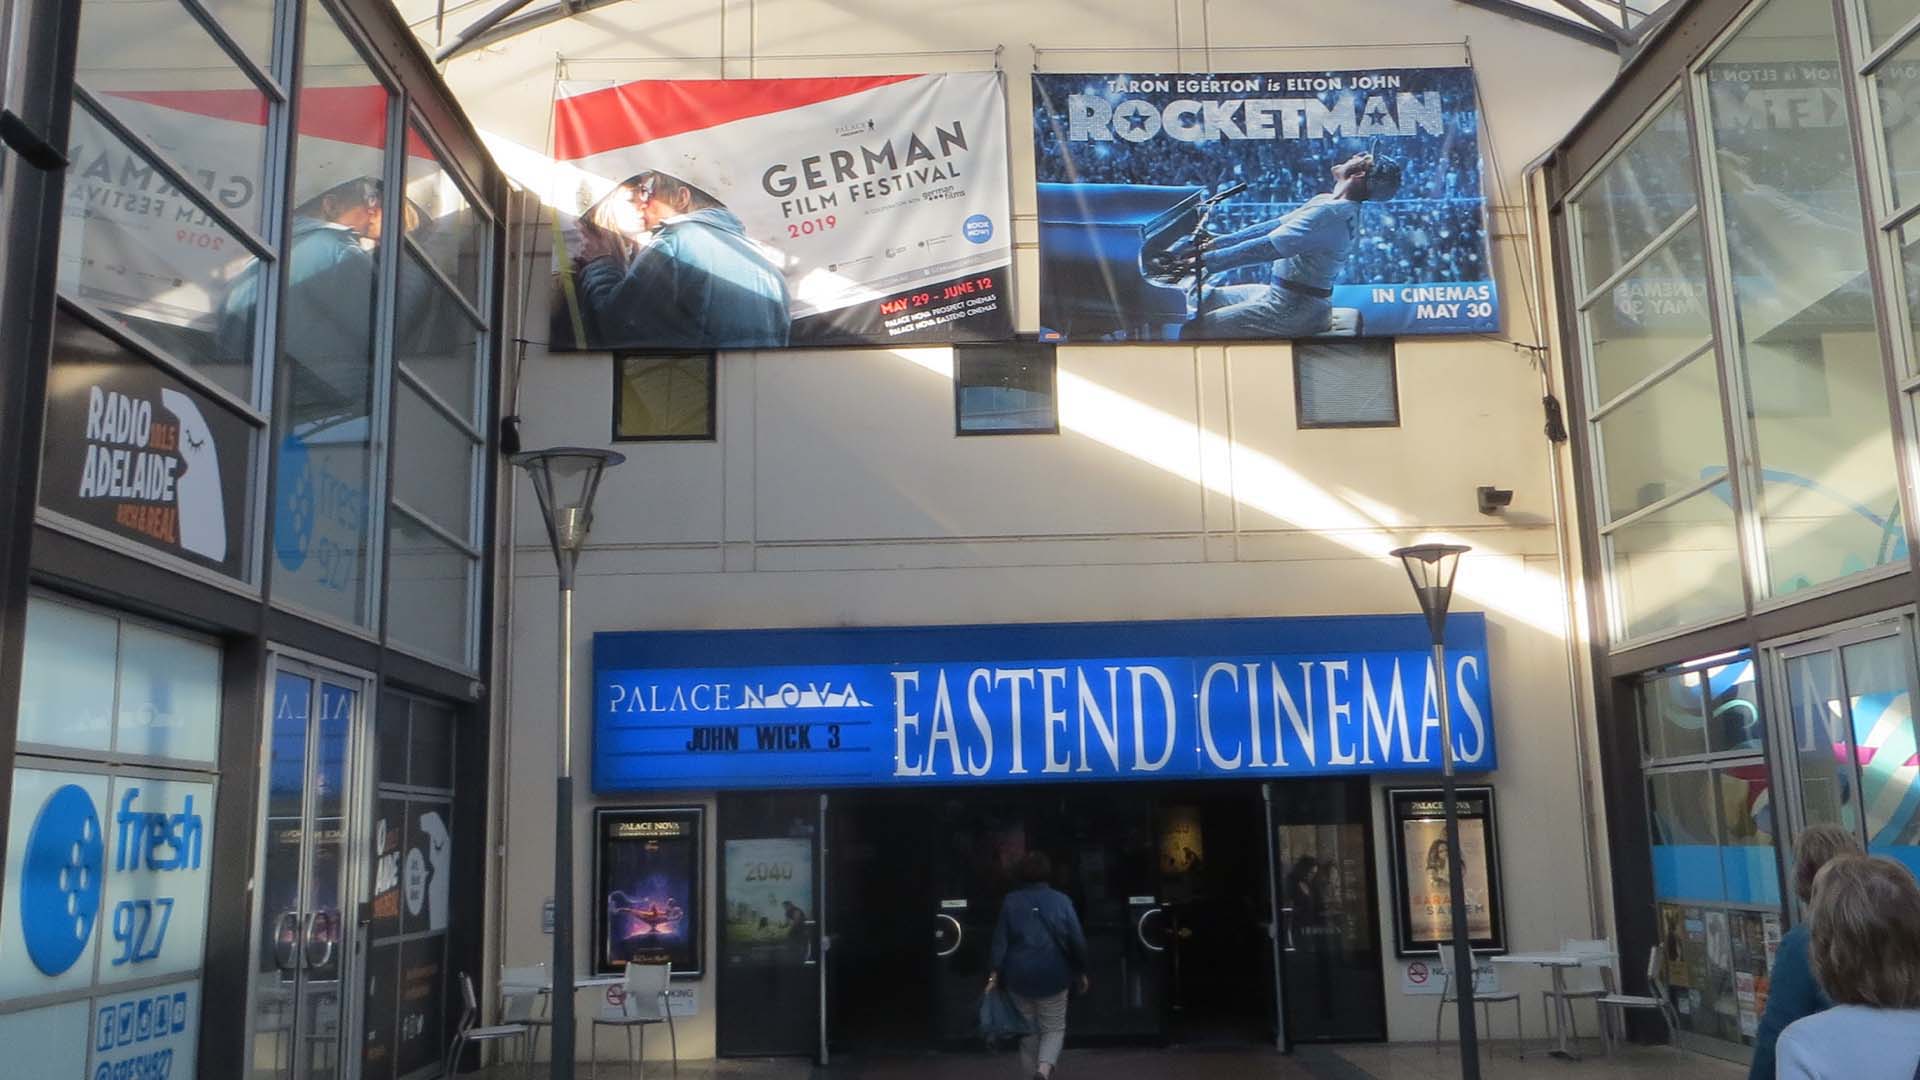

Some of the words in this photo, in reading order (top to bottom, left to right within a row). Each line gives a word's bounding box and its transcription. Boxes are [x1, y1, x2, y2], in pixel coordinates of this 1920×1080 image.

[1107, 79, 1169, 95] TARON
[1176, 78, 1260, 93] EGERTON
[1267, 78, 1281, 92] is
[1287, 77, 1342, 92] ELTON
[1350, 74, 1401, 90] JOHN
[1068, 90, 1445, 143] ROCKETMAN
[762, 121, 968, 197] GERMAN
[781, 192, 838, 218] FILM
[849, 162, 960, 202] FESTIVAL
[787, 215, 837, 238] 2019
[880, 298, 910, 315] MAY
[911, 293, 930, 307] 29
[943, 280, 975, 300] JUNE
[976, 277, 993, 292] 12
[885, 314, 911, 328] PALACE
[911, 311, 932, 323] NOVA
[932, 302, 966, 317] PROSPECT
[966, 294, 997, 306] CINEMAS
[1372, 288, 1395, 304] IN
[1401, 286, 1491, 303] CINEMAS
[1416, 304, 1461, 320] MAY
[1466, 302, 1492, 319] 30
[888, 324, 915, 336] PALACE
[916, 319, 937, 331] NOVA
[936, 311, 967, 326] EASTEND
[967, 303, 997, 316] CINEMAS
[86, 384, 152, 448] RADIO
[79, 444, 177, 501] ADELAIDE
[609, 683, 731, 713] PALACE
[734, 682, 874, 710] NOVA
[891, 665, 1177, 777] EASTEND
[1200, 655, 1486, 772] CINEMAS
[686, 726, 739, 751] JOHN
[756, 725, 811, 750] WICK
[827, 724, 841, 749] 3
[116, 787, 203, 872] fresh
[744, 861, 794, 882] 2040
[111, 897, 175, 966] 927
